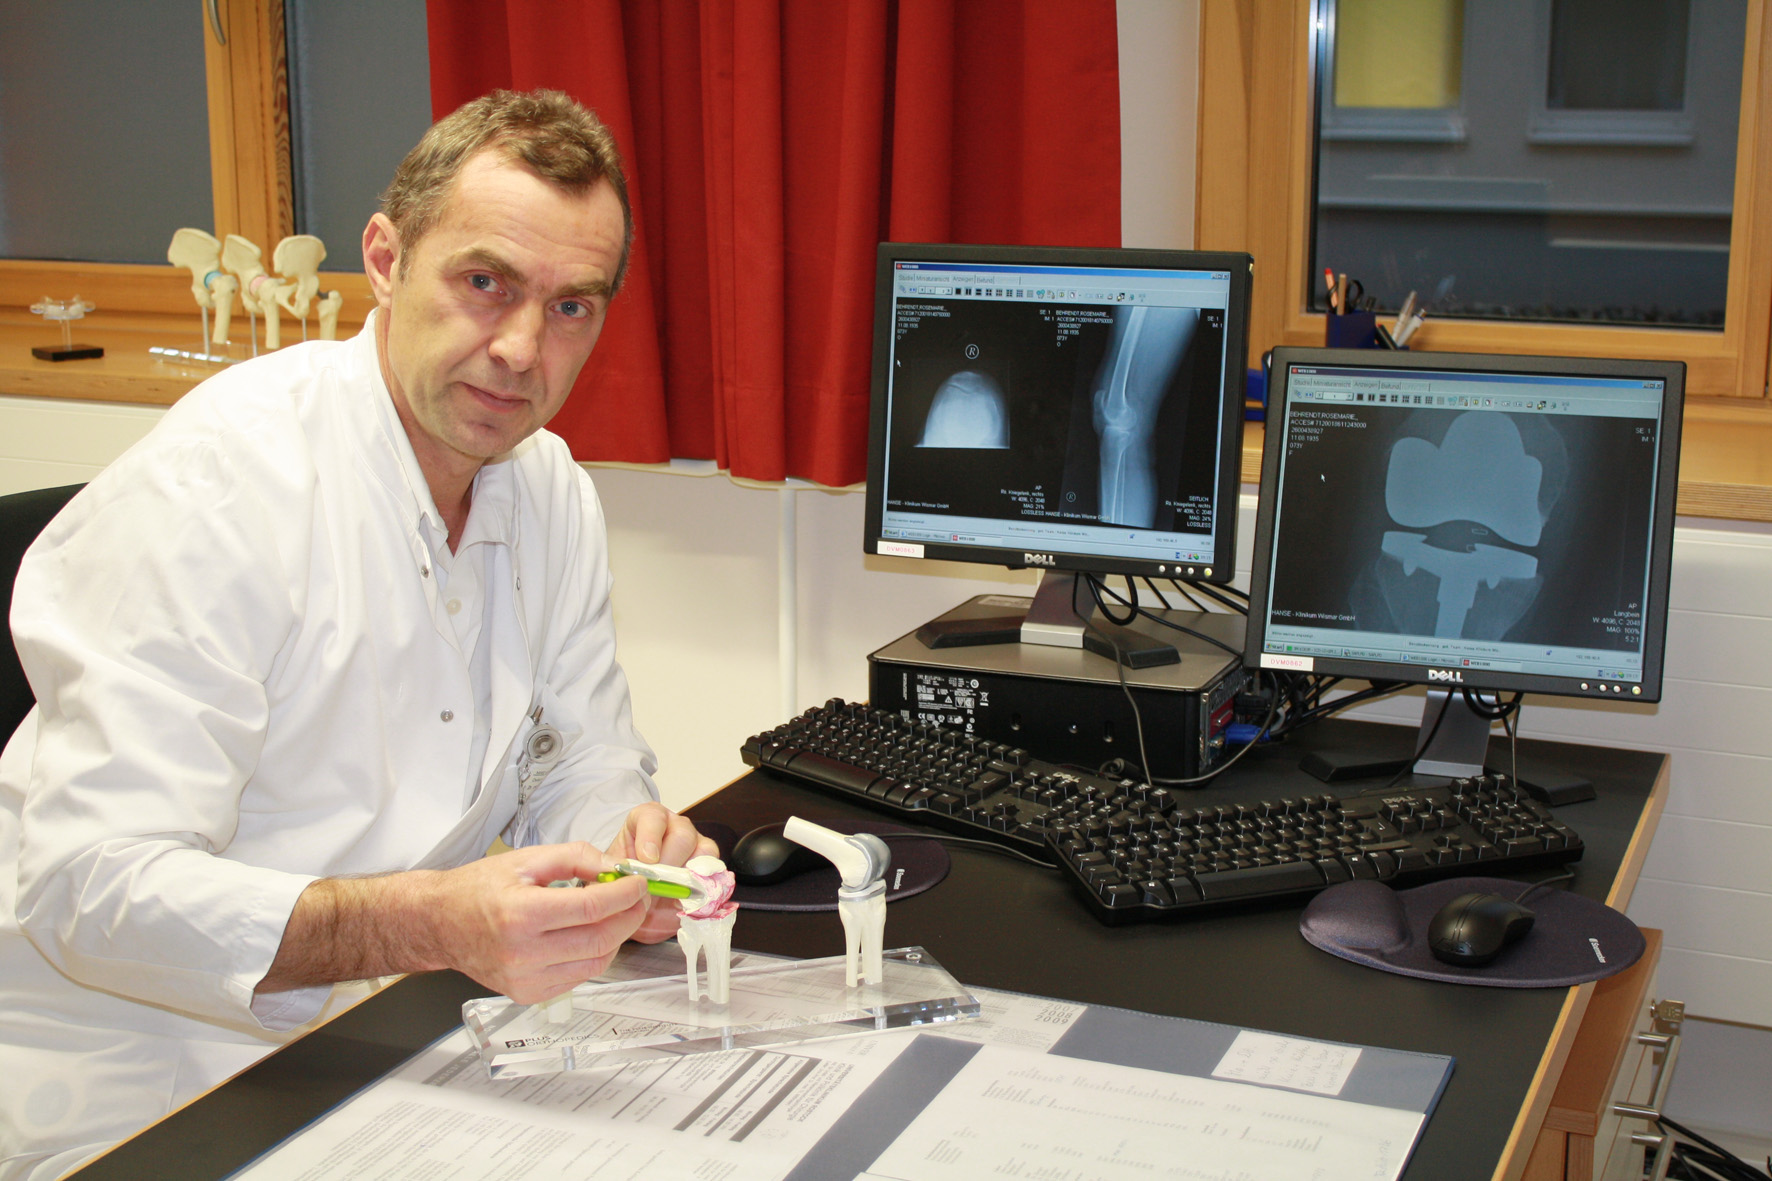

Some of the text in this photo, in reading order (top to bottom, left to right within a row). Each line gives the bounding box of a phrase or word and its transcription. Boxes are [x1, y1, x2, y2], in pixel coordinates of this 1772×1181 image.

[1024, 553, 1056, 566] DELL
[1271, 658, 1303, 666] DVM0862
[1428, 669, 1463, 682] DELL
[1046, 1002, 1079, 1012] 2007
[1040, 1009, 1073, 1018] 2008
[1034, 1014, 1069, 1024] 2009
[525, 1033, 600, 1047] ORTHOPEDICS
